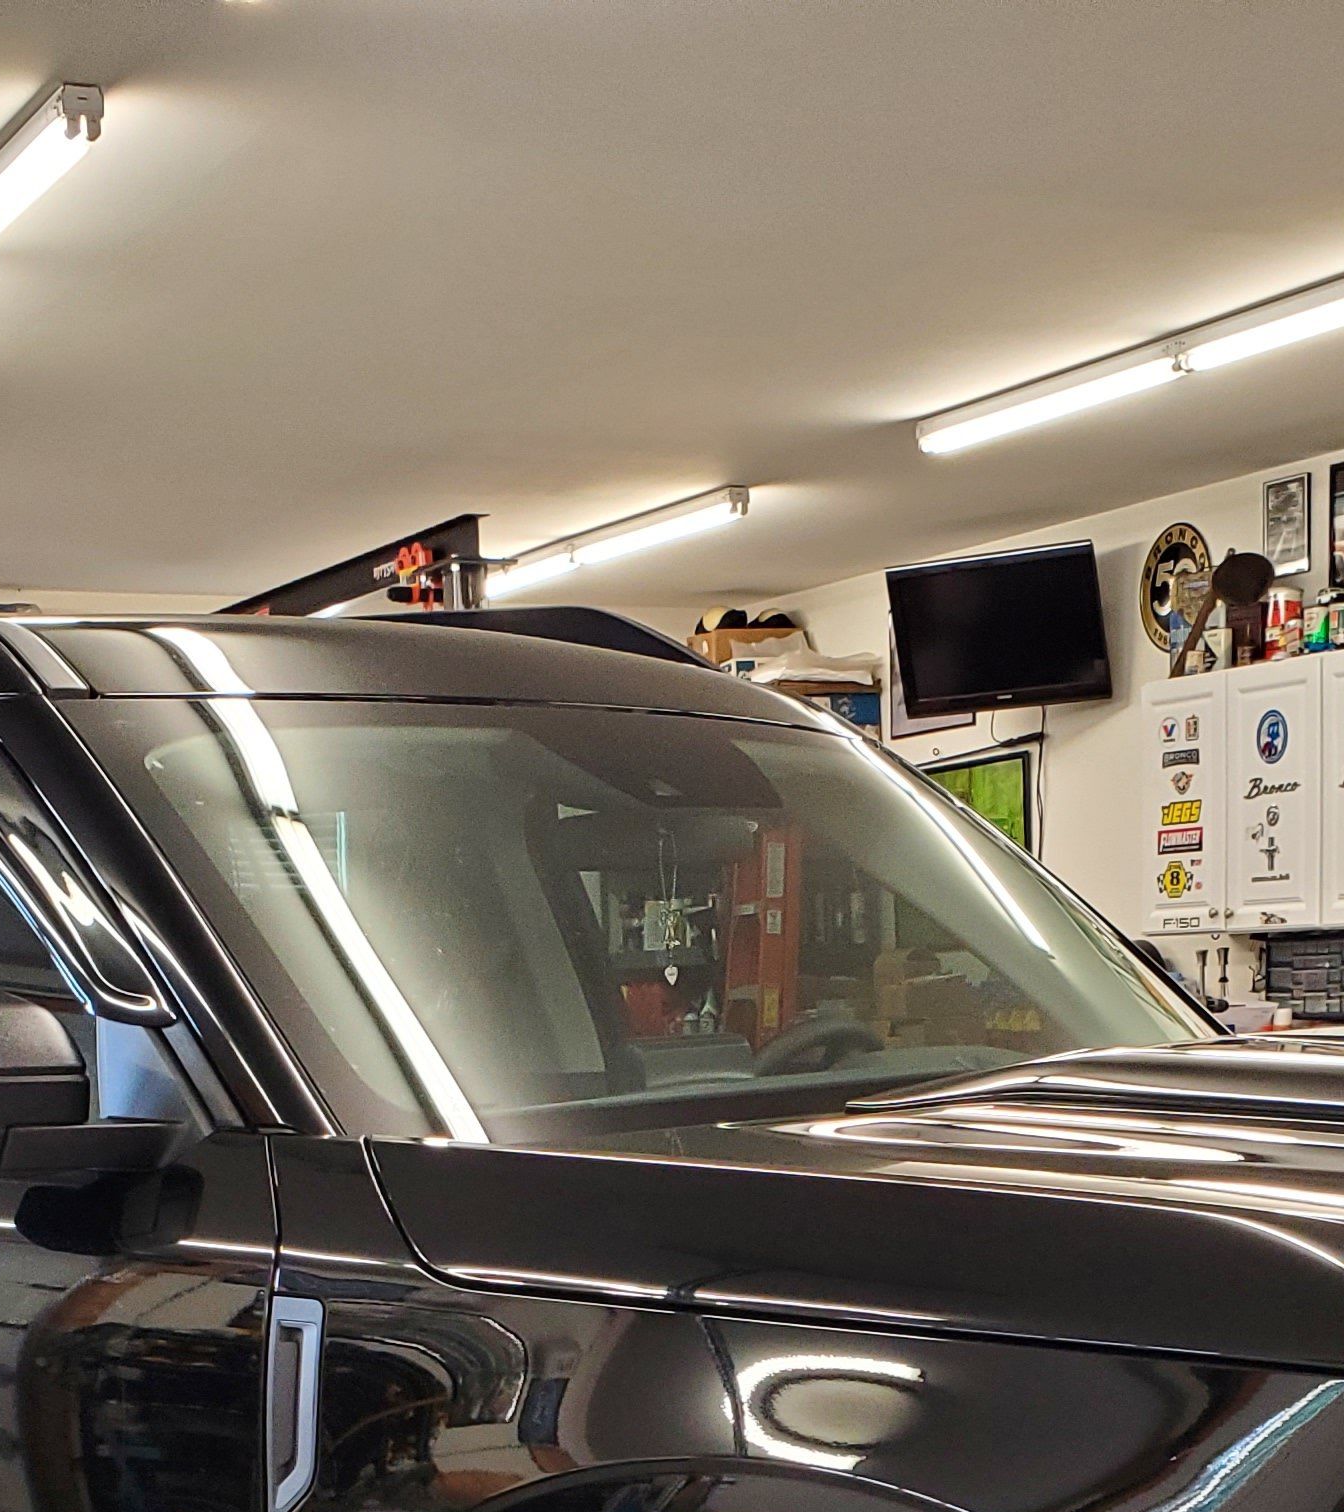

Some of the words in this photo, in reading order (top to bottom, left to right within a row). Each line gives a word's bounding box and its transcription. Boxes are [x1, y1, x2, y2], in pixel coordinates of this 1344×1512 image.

[1243, 777, 1301, 799] Bronco
[1163, 801, 1201, 824] JEGS
[1169, 870, 1181, 886] 8
